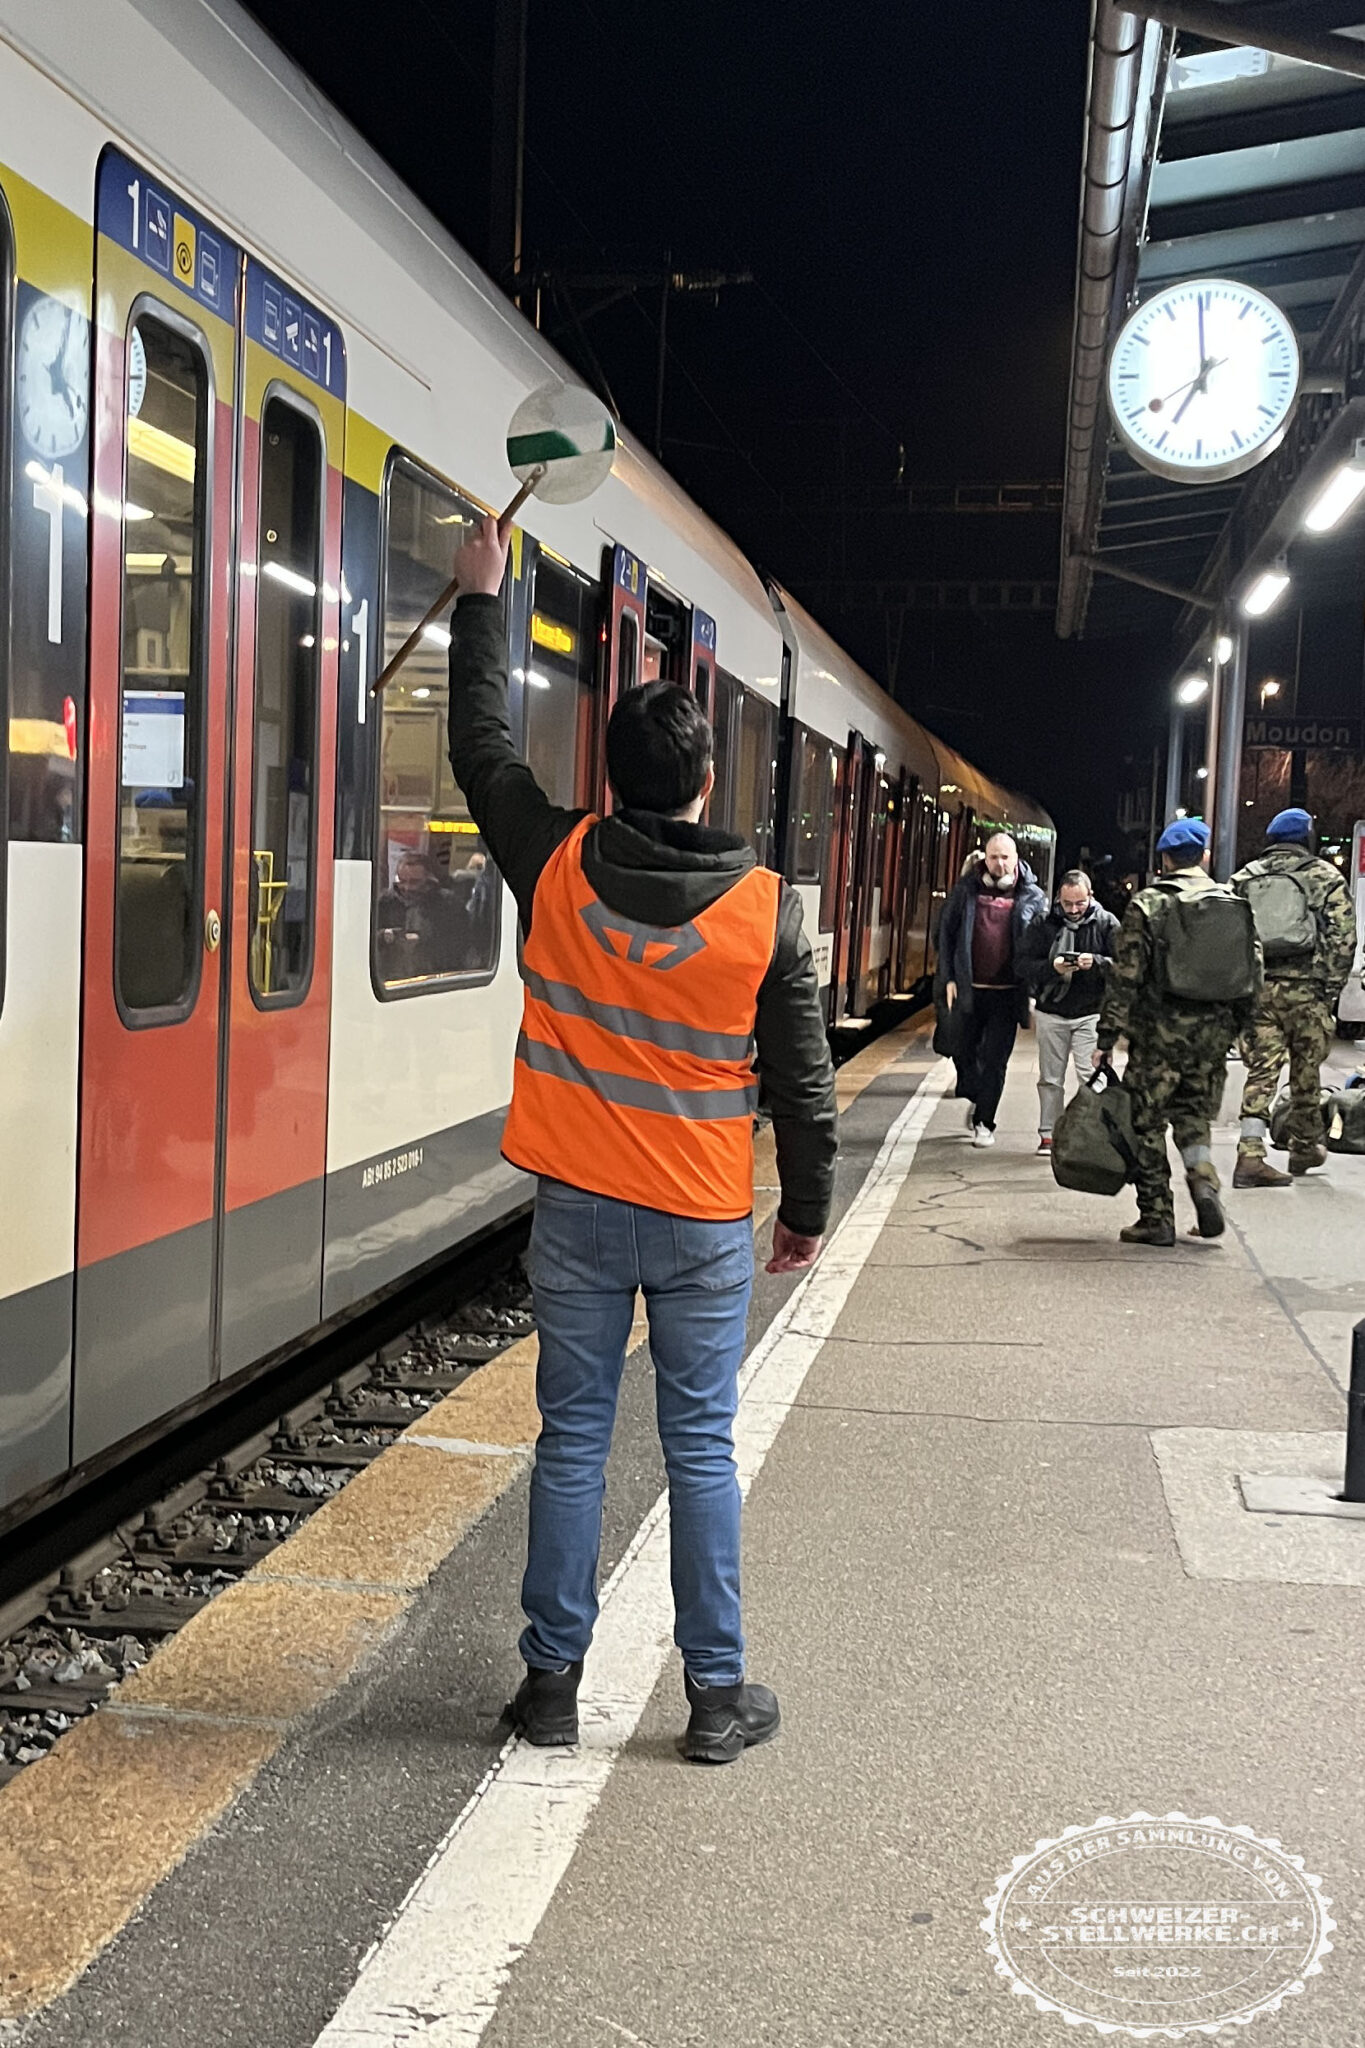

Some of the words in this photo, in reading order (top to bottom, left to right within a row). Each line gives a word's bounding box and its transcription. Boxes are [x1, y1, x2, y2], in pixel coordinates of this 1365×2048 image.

[128, 179, 140, 249] 1
[323, 331, 332, 386] 1
[33, 462, 64, 644] 1
[352, 598, 368, 724] 1
[1246, 721, 1350, 744] Moudon
